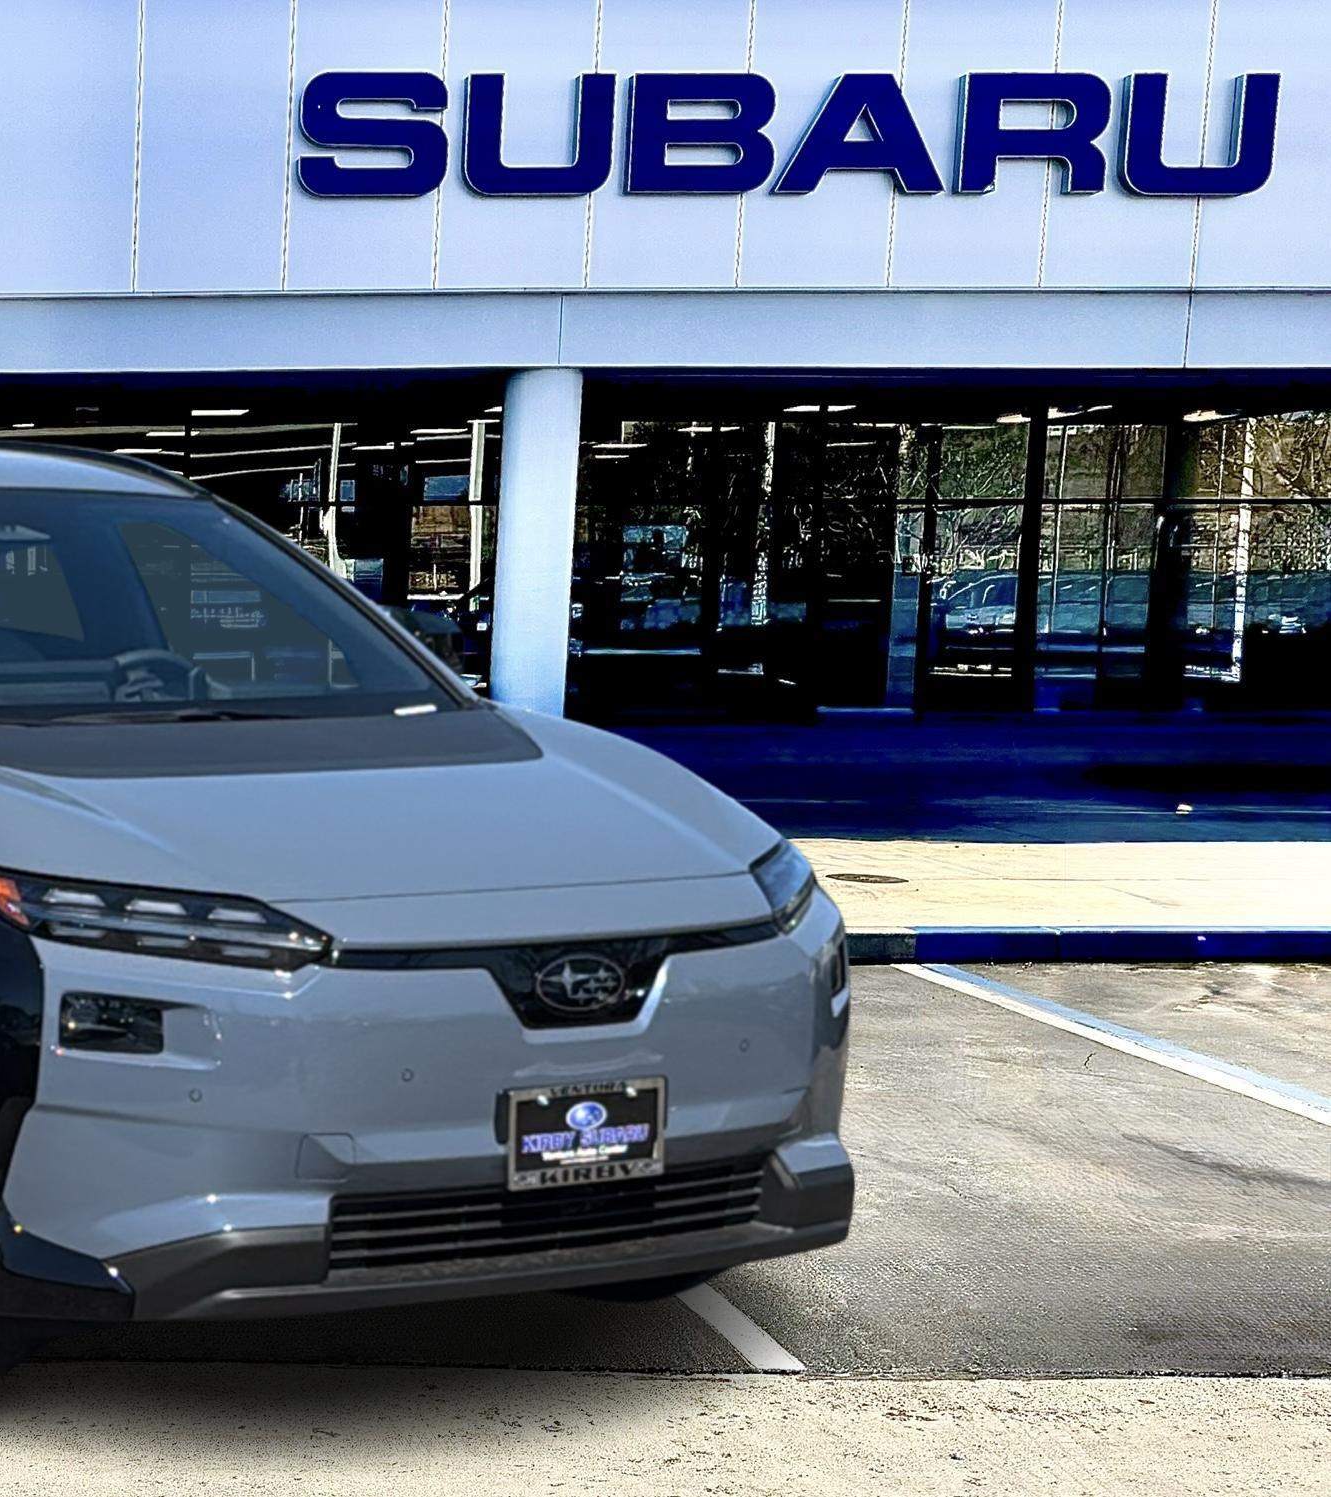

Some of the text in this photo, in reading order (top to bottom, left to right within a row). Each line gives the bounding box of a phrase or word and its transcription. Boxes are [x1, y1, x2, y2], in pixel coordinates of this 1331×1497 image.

[296, 71, 1280, 199] SUBARU
[550, 1081, 627, 1097] VENTURA
[521, 1132, 576, 1153] KIRBY
[580, 1123, 649, 1148] SUBARU
[540, 1164, 635, 1185] KIRBY
